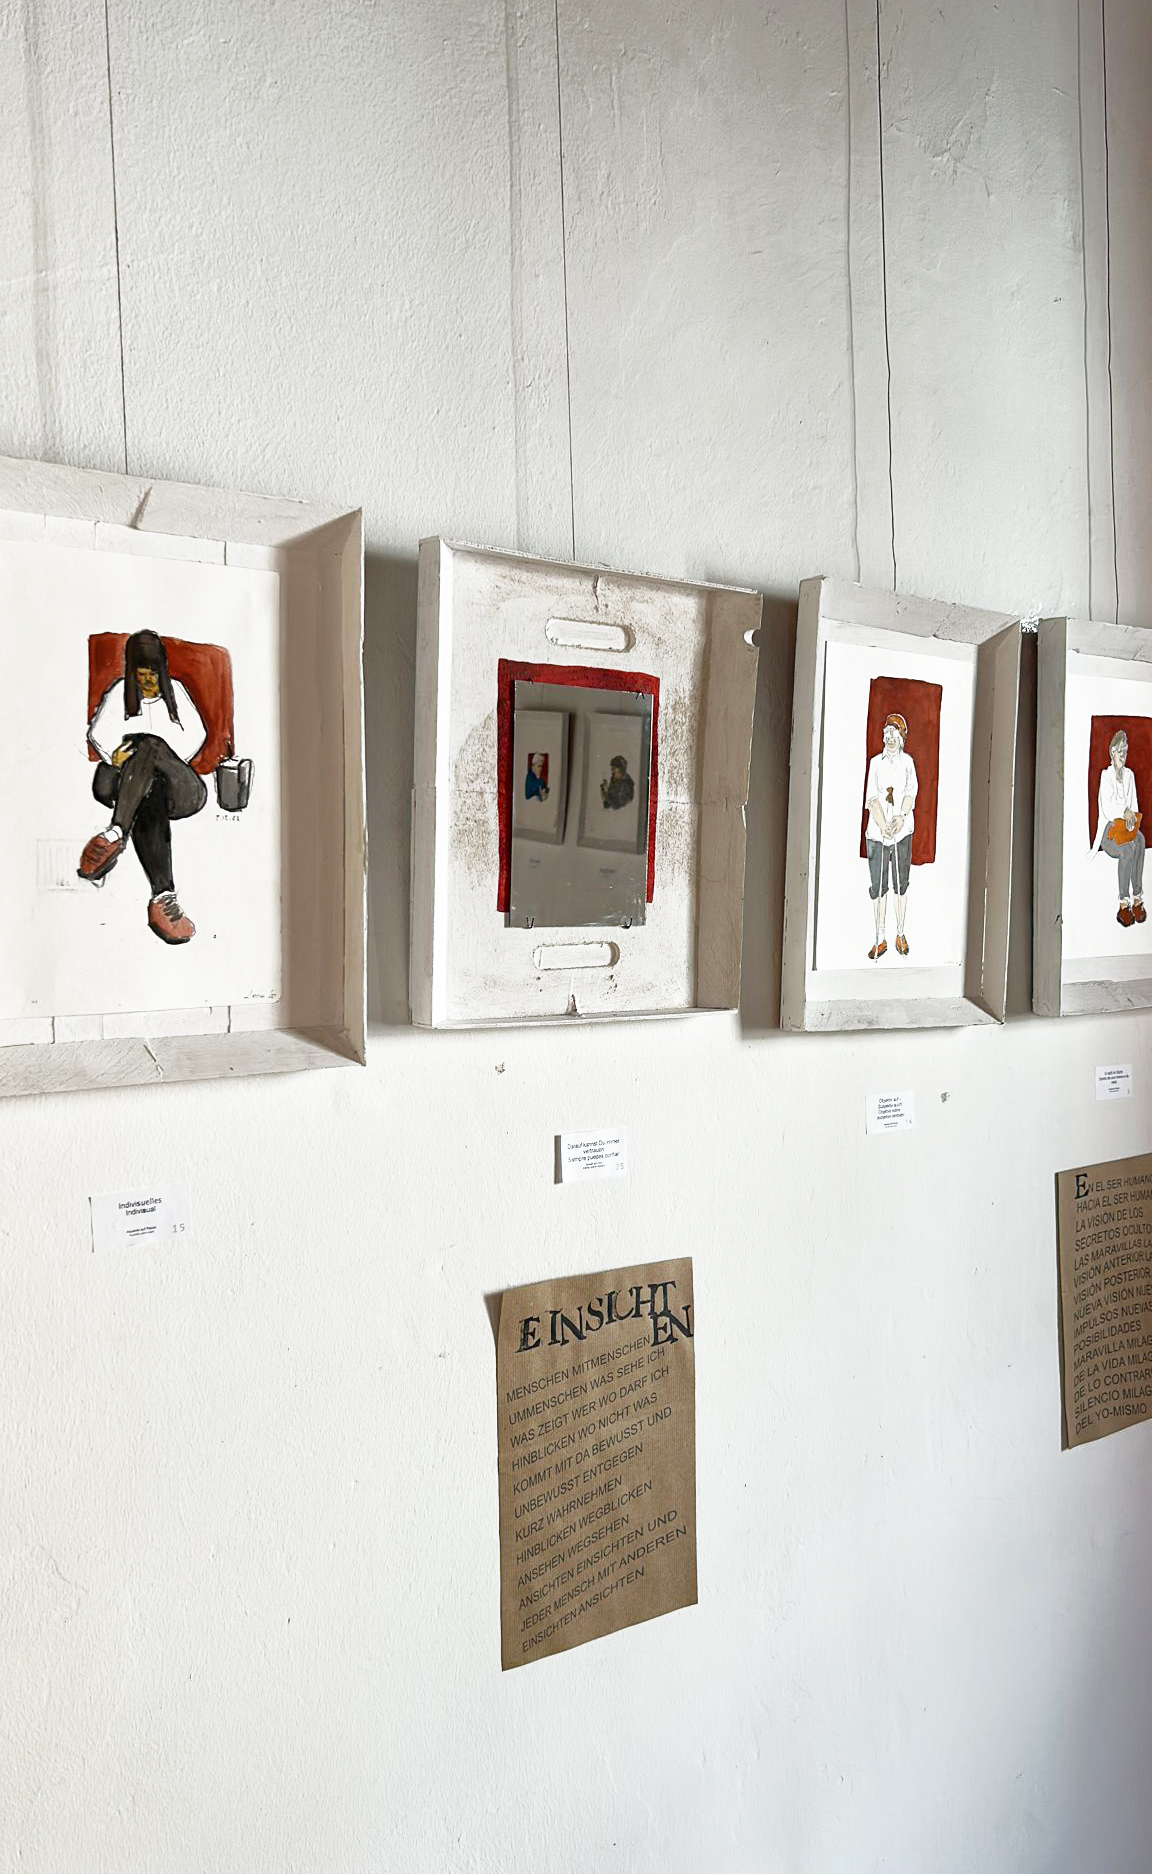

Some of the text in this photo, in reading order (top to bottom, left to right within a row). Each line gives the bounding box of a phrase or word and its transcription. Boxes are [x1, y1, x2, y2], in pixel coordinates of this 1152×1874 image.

[1096, 1181, 1105, 1192] EL
[1107, 1179, 1122, 1190] SER
[1076, 1198, 1101, 1214] HACIA
[1102, 1196, 1112, 1207] EL
[1114, 1192, 1130, 1205] SER
[1076, 1221, 1086, 1233] LA
[1116, 1209, 1127, 1222] DE
[1129, 1207, 1144, 1220] LOS
[1074, 1254, 1090, 1271] LAS
[1091, 1238, 1142, 1261] MARAVILLAS
[1075, 1227, 1120, 1252] SECRETOS
[1103, 1251, 1144, 1274] ANTERIOR
[1104, 1267, 1151, 1290] POSTERIOR
[1073, 1300, 1102, 1322] NUEVA
[1074, 1308, 1118, 1338] IMPULSOS
[1073, 1320, 1141, 1354] POSIBILIDADES
[506, 1334, 650, 1403] MENSCHEN MITMENSCHEN
[1073, 1340, 1125, 1372] MARAVILLA
[1074, 1370, 1085, 1387] DE
[1088, 1363, 1100, 1376] LA
[1102, 1357, 1126, 1371] VIDA
[508, 1348, 665, 1426] UMMENSCHEN WAS SEHE ICH
[1074, 1386, 1085, 1404] DE
[1088, 1378, 1100, 1392] LO
[510, 1366, 670, 1448] WAS ZEIGT WER WO DARF ICH
[1074, 1390, 1120, 1419] SILENCIO
[1075, 1402, 1147, 1435] DEL YO-MISMO
[512, 1392, 658, 1472] HINBLICKEN WO NICHT WAS
[513, 1406, 672, 1495] KOMMT MIT DA BEWUSST UND
[514, 1443, 644, 1519] UNBEWUSST ENTGEGEN
[515, 1475, 622, 1542] KURZ WAHRNEHMEN
[516, 1480, 652, 1566] HINBLICKEN WEGBLICKEN
[518, 1514, 630, 1588] ANSEHEN WEGSEHEN
[519, 1510, 678, 1610] ANSICHTEN EINSICHTEN UND
[521, 1526, 686, 1632] JEDER MENSCH MIT ANDEREN
[522, 1566, 645, 1653] EINSICHTEN ANSICHTEN
